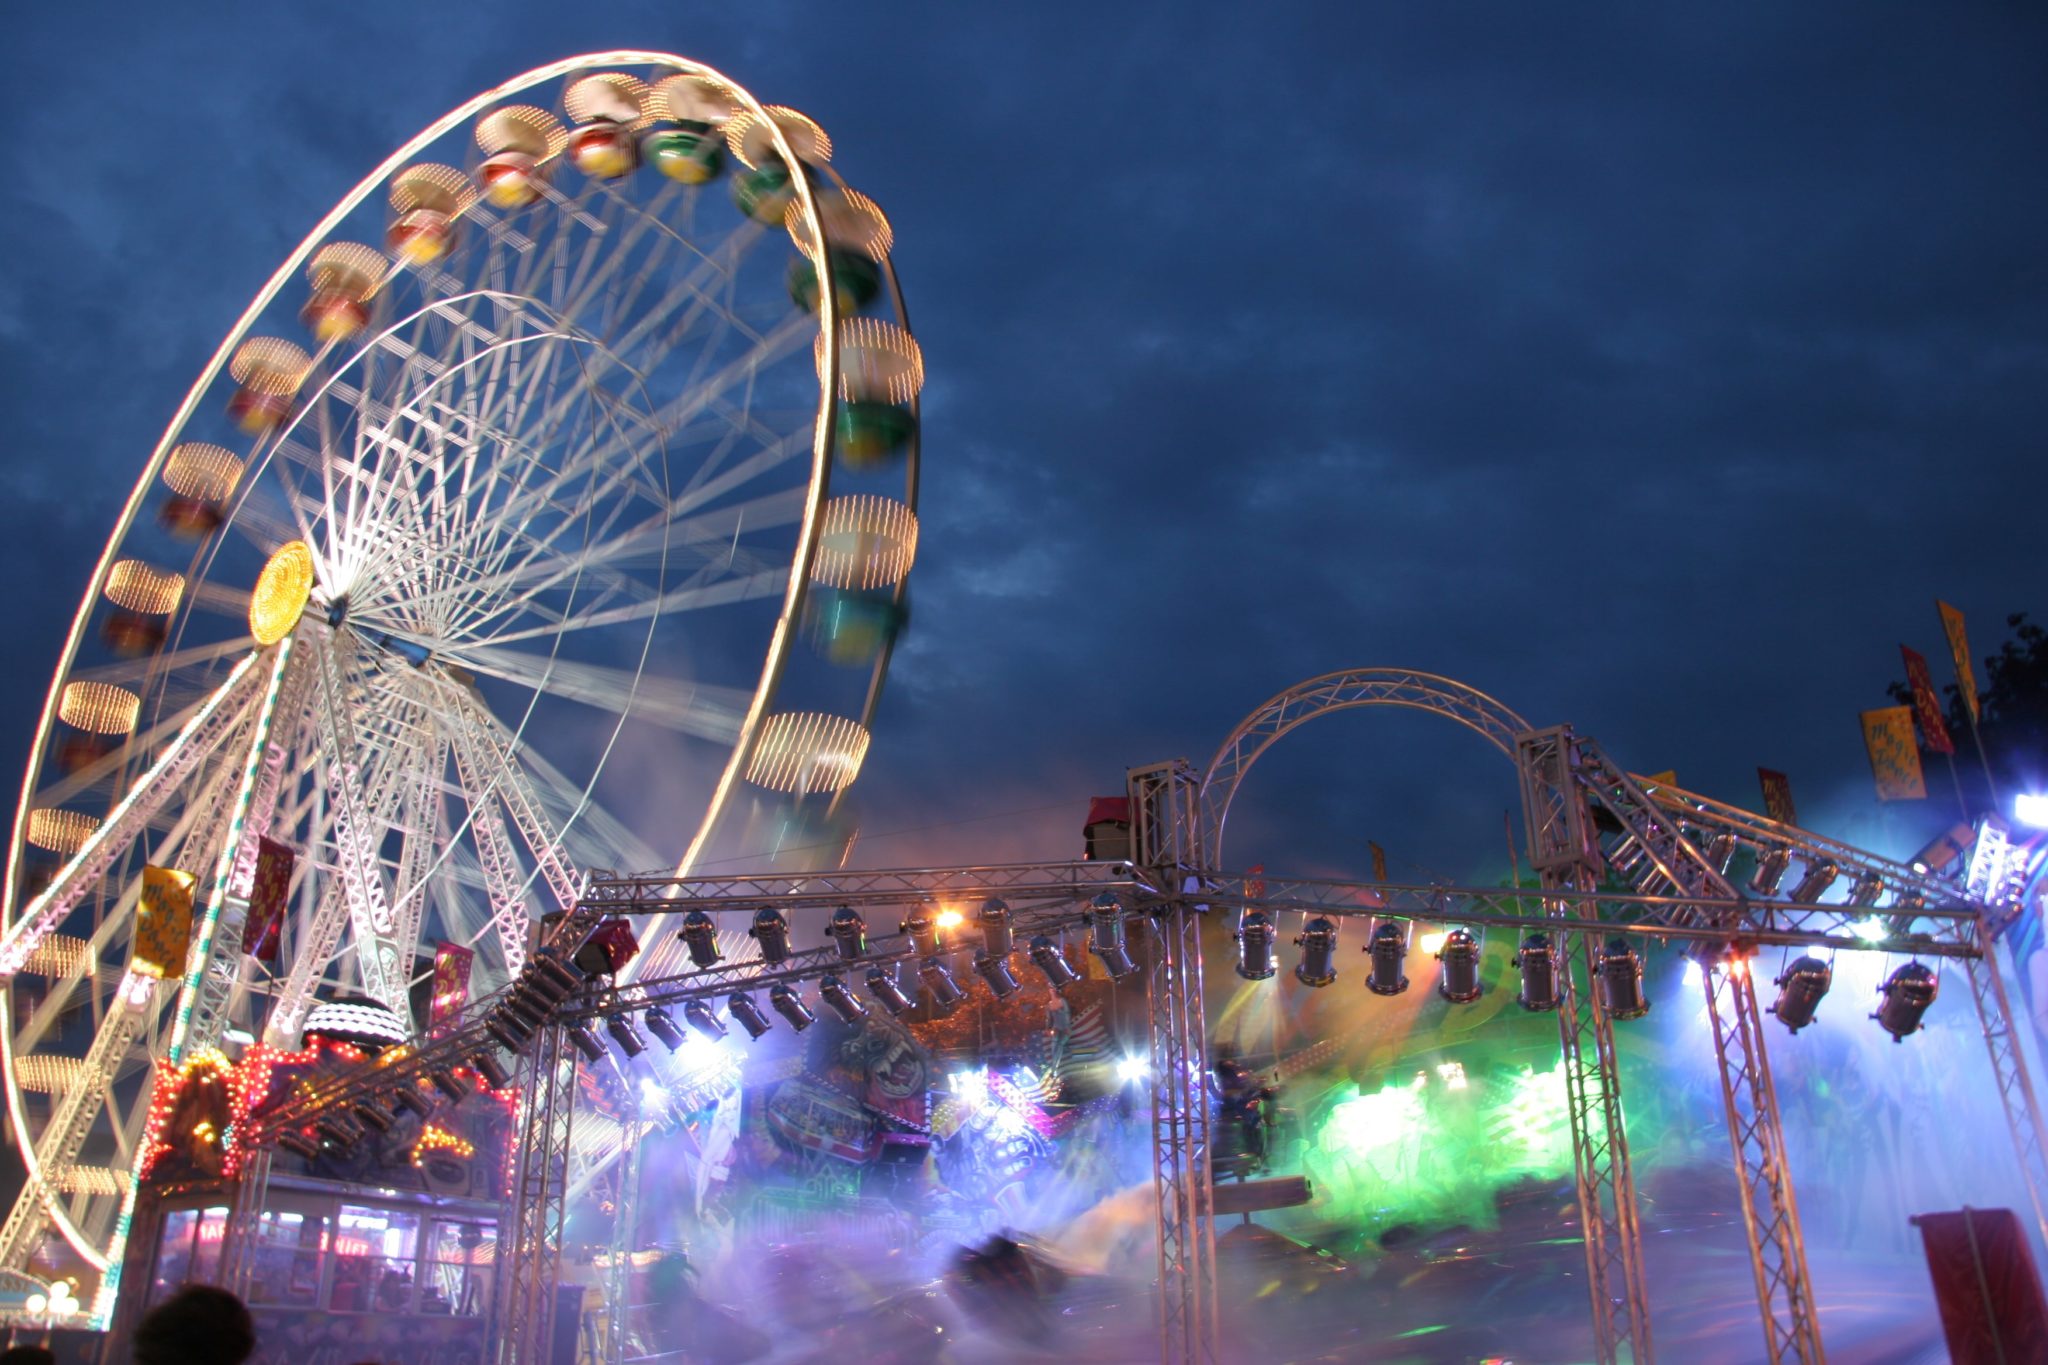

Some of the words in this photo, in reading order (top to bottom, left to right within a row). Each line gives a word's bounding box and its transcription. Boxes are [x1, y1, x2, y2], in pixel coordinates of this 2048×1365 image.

[1872, 723, 1917, 766] Magic
[1874, 748, 1918, 790] Dance
[144, 884, 185, 943] Magic
[141, 915, 177, 970] Dance
